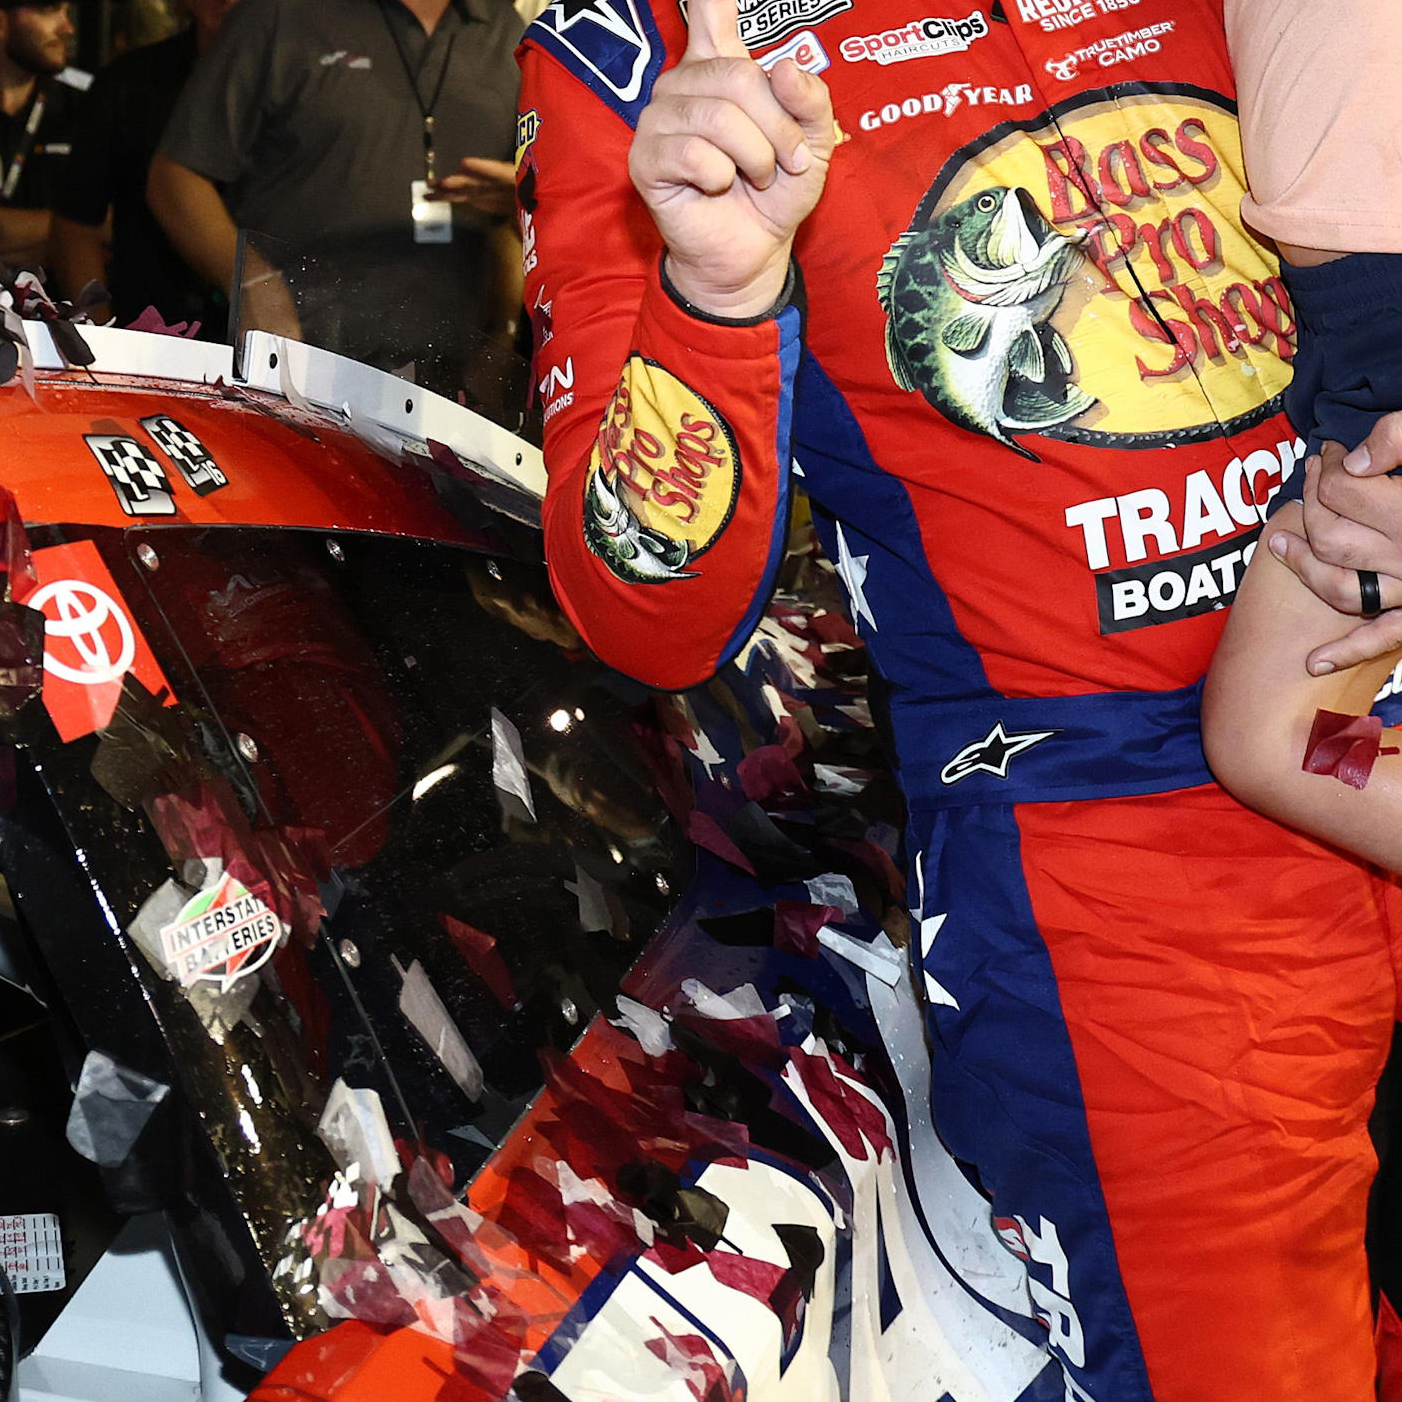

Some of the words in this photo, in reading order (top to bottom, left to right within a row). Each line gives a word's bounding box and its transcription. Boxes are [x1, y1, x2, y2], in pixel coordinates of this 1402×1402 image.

[1039, 0, 1097, 33] SINCE
[1074, 21, 1174, 63] TRUETIMBER
[880, 37, 962, 61] HAIRCUTS
[1098, 38, 1162, 68] CAMO
[1039, 117, 1219, 225] Bass
[1076, 206, 1218, 296] Pro
[1128, 275, 1297, 382] Shop
[200, 459, 228, 486] 16
[614, 428, 661, 502] Pro
[651, 412, 724, 524] Shops
[169, 897, 262, 952] INTERSTAT
